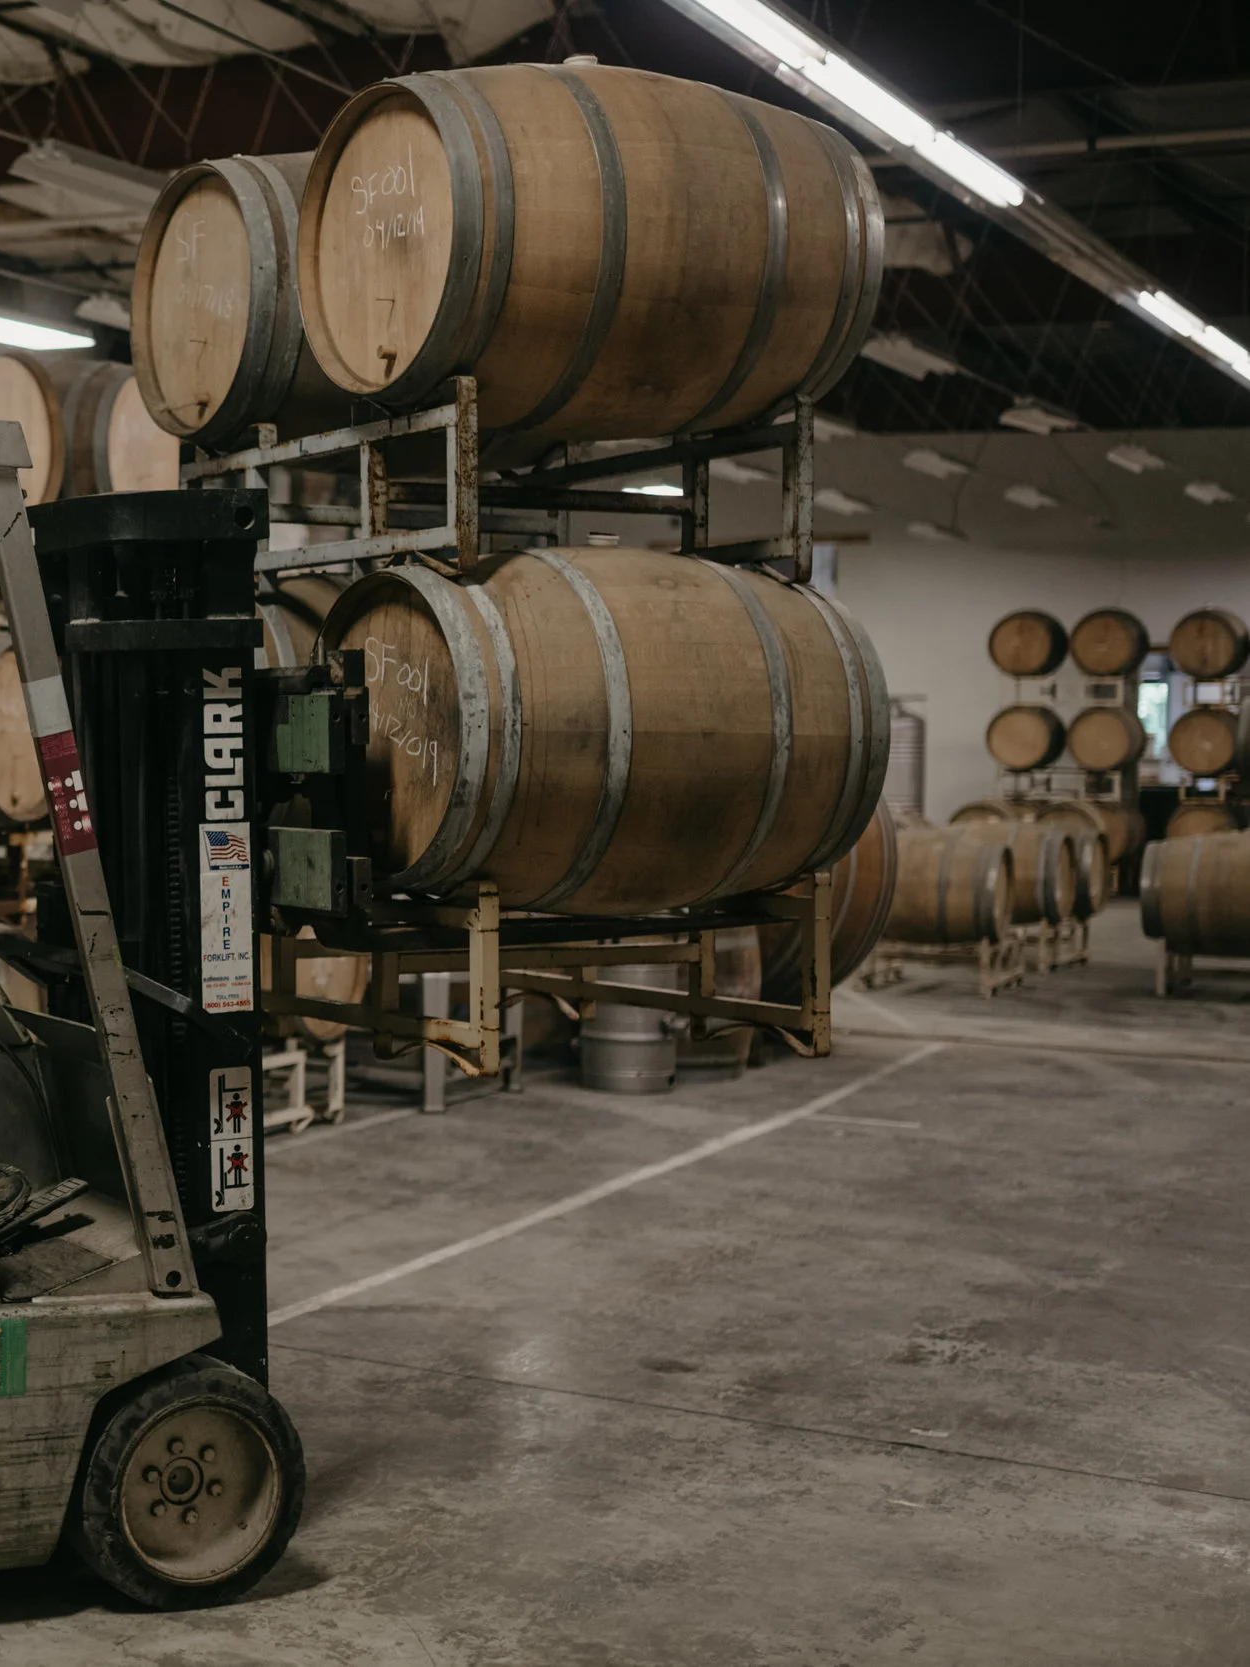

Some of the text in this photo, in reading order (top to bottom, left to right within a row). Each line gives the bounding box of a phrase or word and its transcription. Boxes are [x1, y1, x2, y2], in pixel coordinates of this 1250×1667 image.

[363, 205, 425, 251] 04/12/19
[202, 667, 244, 820] CLARK
[221, 876, 231, 950] EMPIRE
[203, 952, 250, 962] FORKLIFT, INC.
